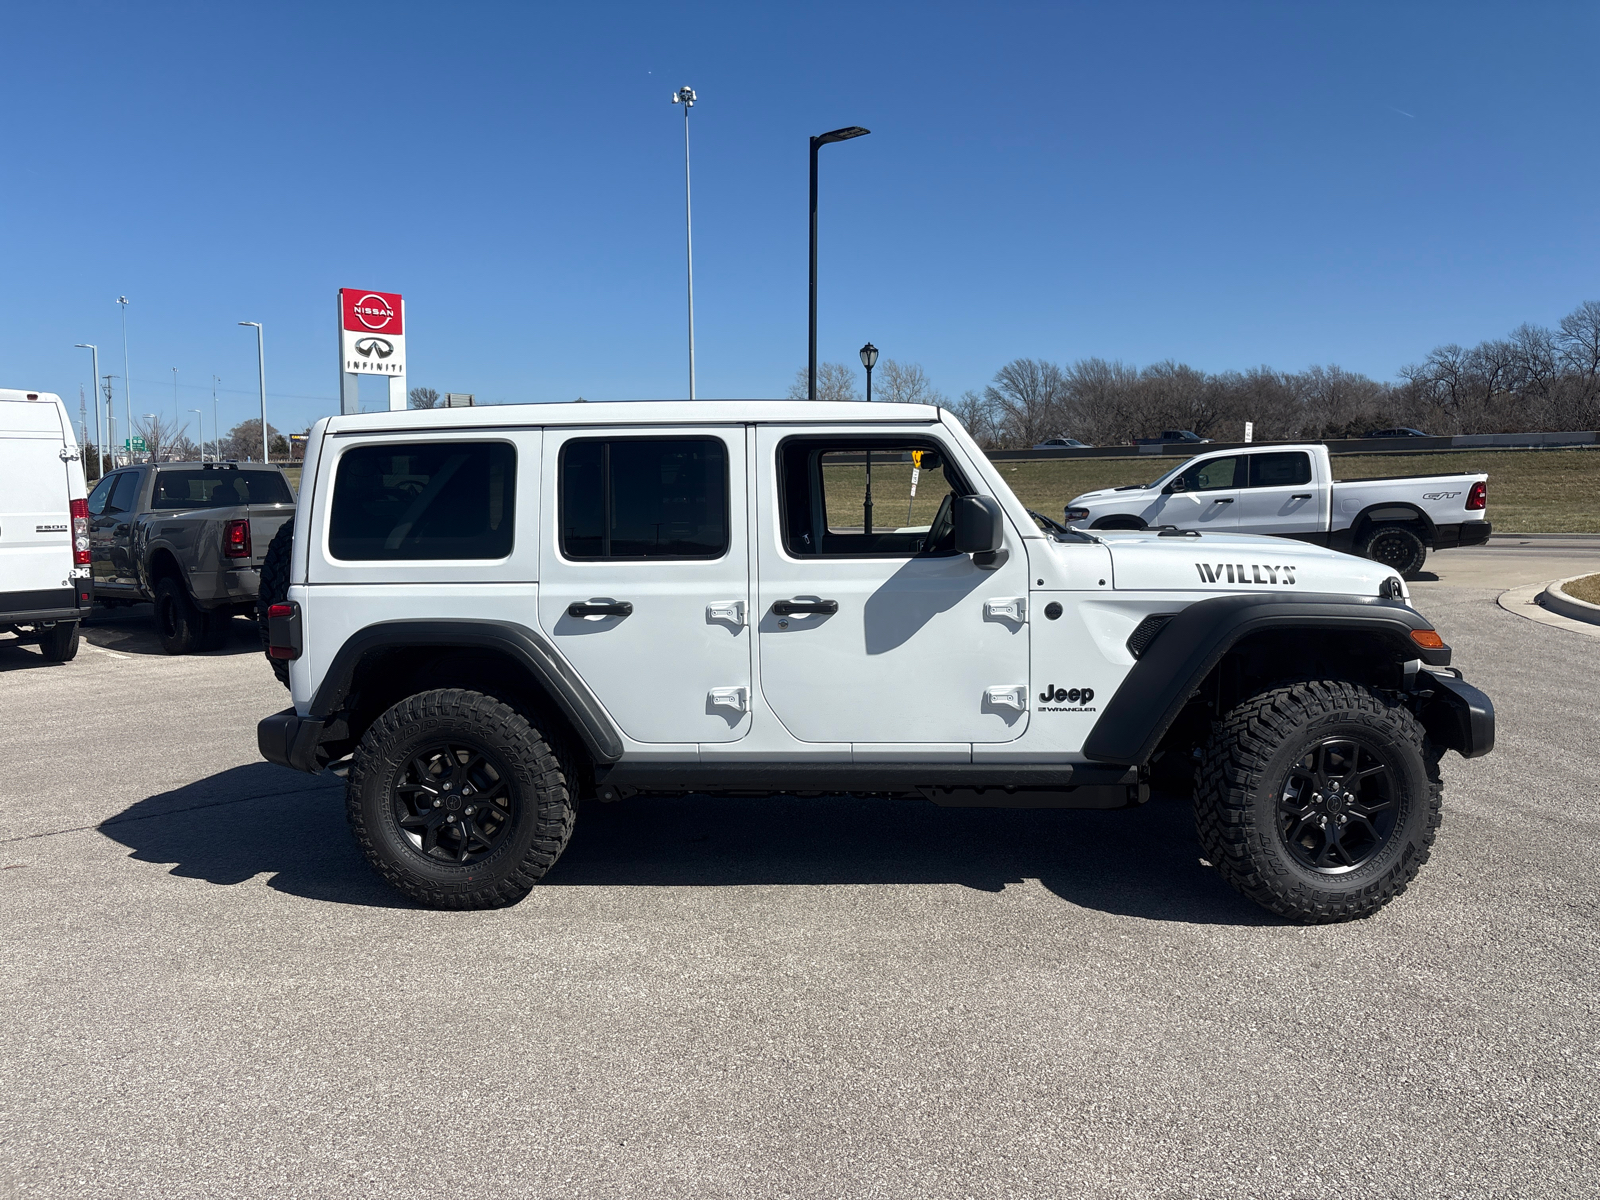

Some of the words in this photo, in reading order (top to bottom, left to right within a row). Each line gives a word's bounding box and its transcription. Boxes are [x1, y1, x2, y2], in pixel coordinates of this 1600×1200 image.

[354, 306, 394, 317] NISSAN
[347, 360, 403, 373] INFINITI
[1194, 562, 1296, 585] WILLYS
[1039, 683, 1095, 706] Jeep
